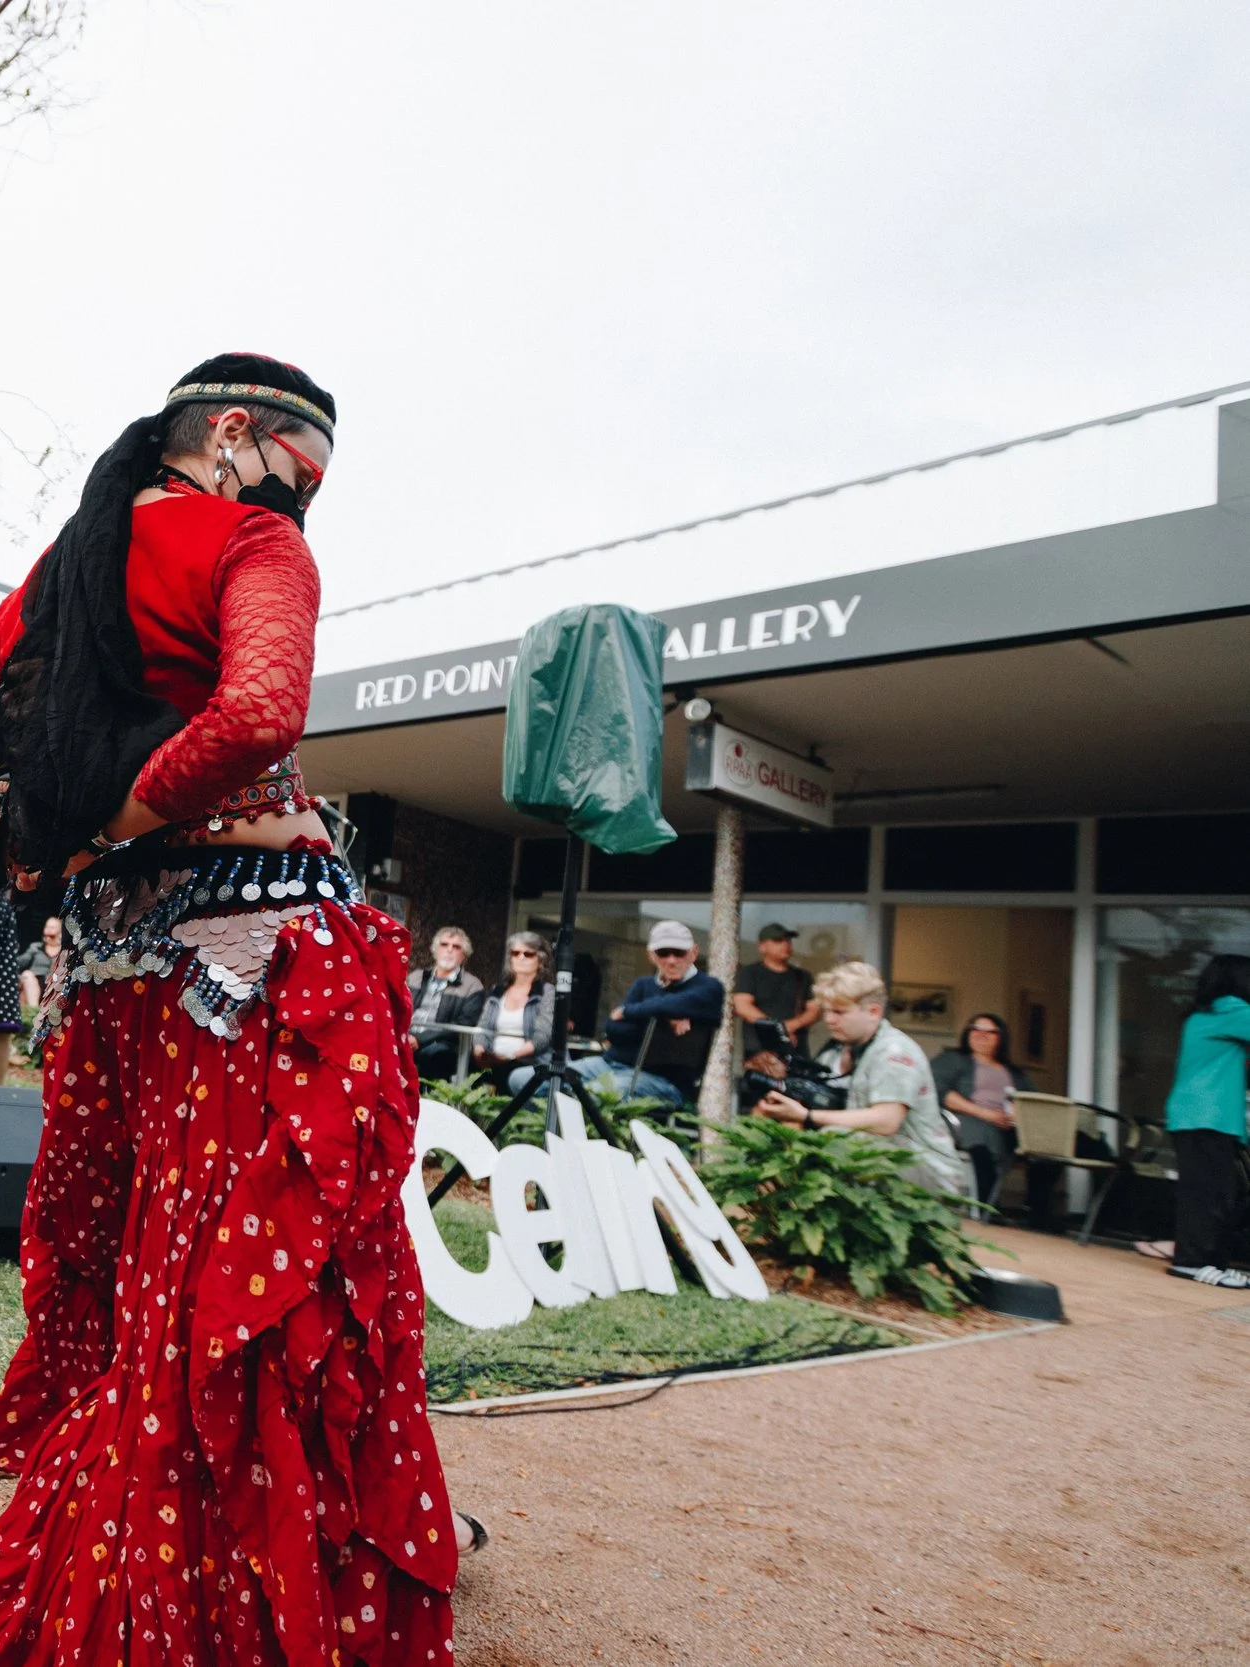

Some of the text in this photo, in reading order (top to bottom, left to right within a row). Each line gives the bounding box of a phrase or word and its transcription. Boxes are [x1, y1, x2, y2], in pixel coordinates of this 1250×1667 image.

[355, 675, 418, 711] RED
[661, 594, 862, 662] ALLERY
[757, 761, 828, 808] GALLERY
